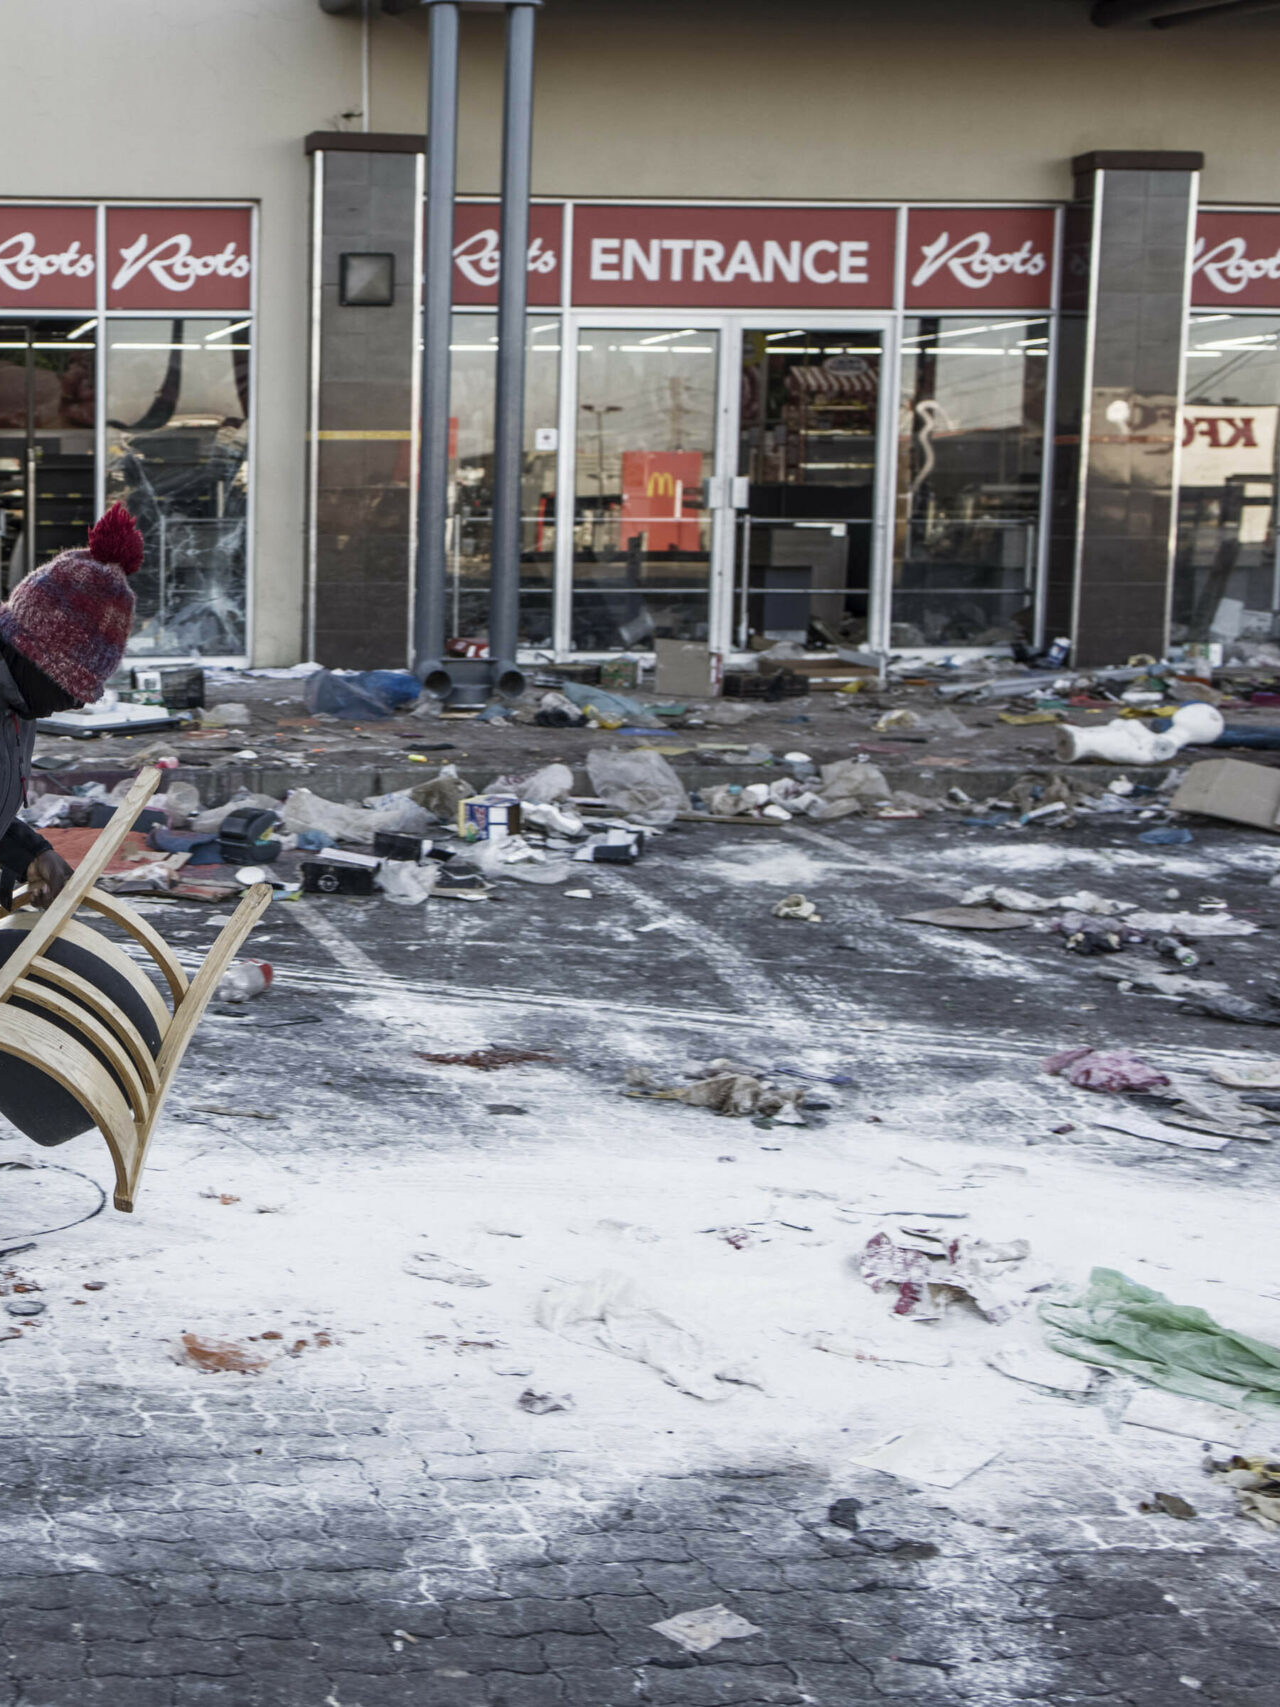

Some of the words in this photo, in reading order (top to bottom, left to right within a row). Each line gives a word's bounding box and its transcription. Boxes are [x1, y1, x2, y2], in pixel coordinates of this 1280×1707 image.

[111, 233, 252, 292] Roots
[590, 238, 869, 284] ENTRANCE
[911, 231, 1046, 289] Roots
